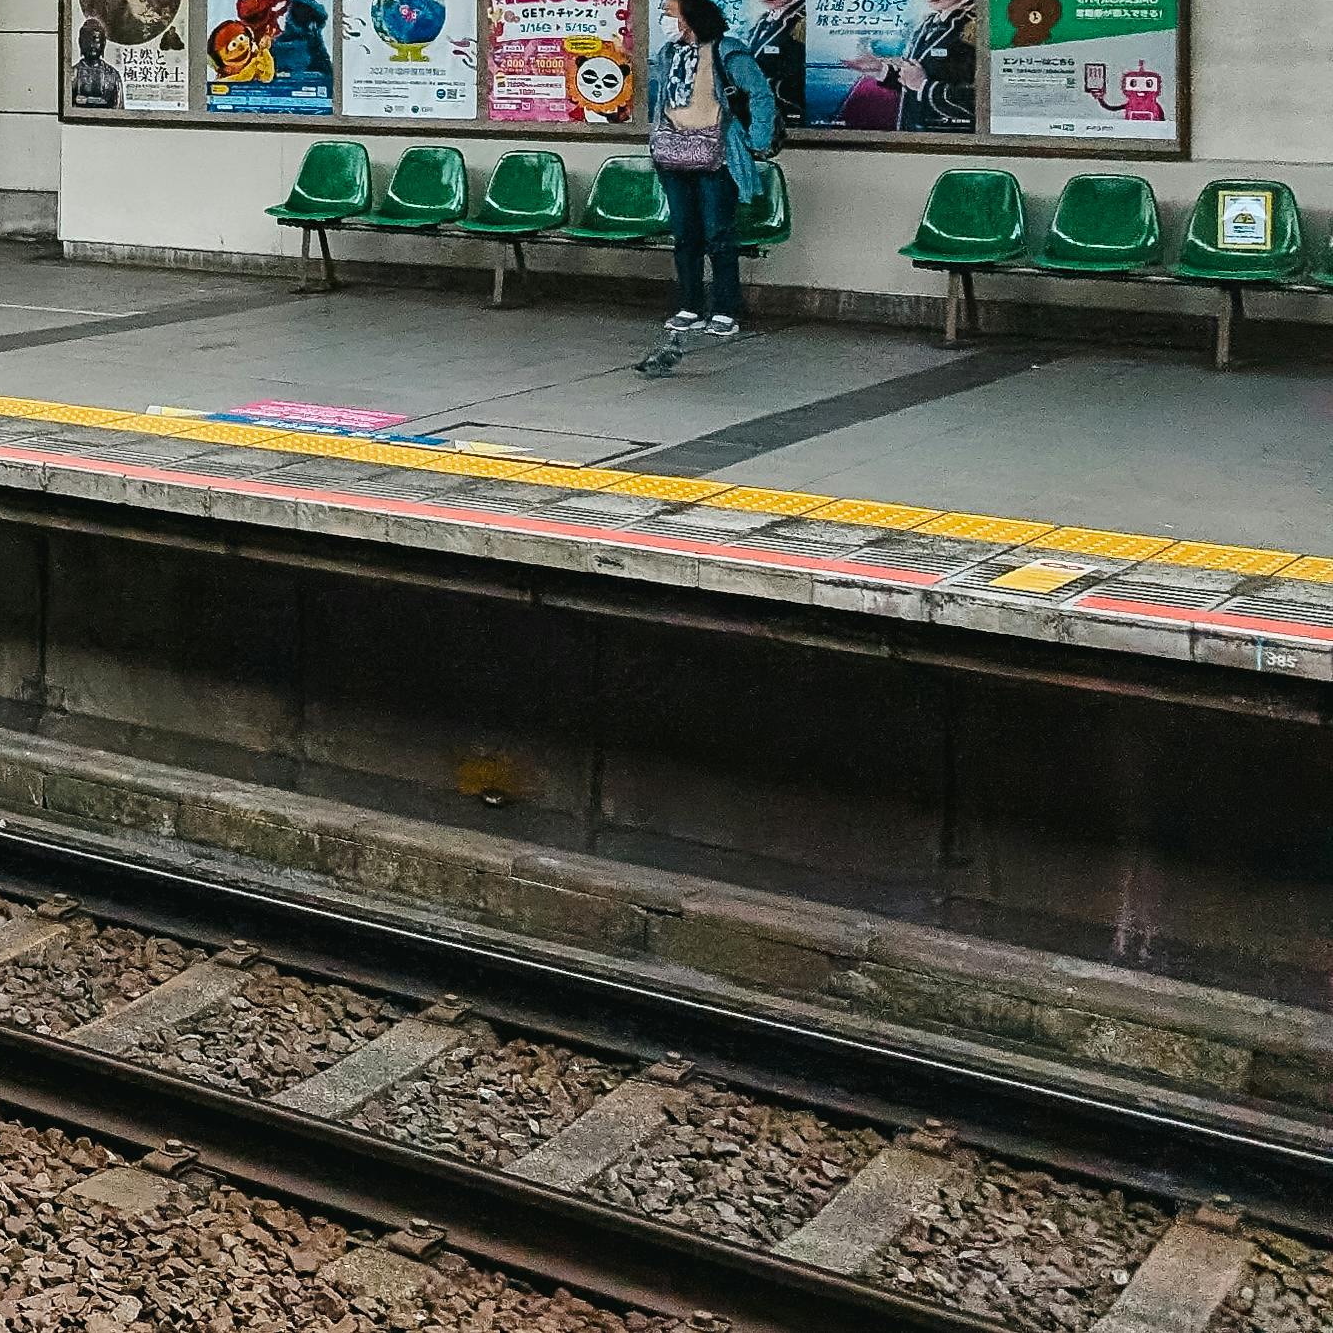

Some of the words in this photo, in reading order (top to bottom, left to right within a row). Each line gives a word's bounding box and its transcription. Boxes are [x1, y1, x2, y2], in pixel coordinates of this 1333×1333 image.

[521, 7, 599, 19] GETのチャンス!
